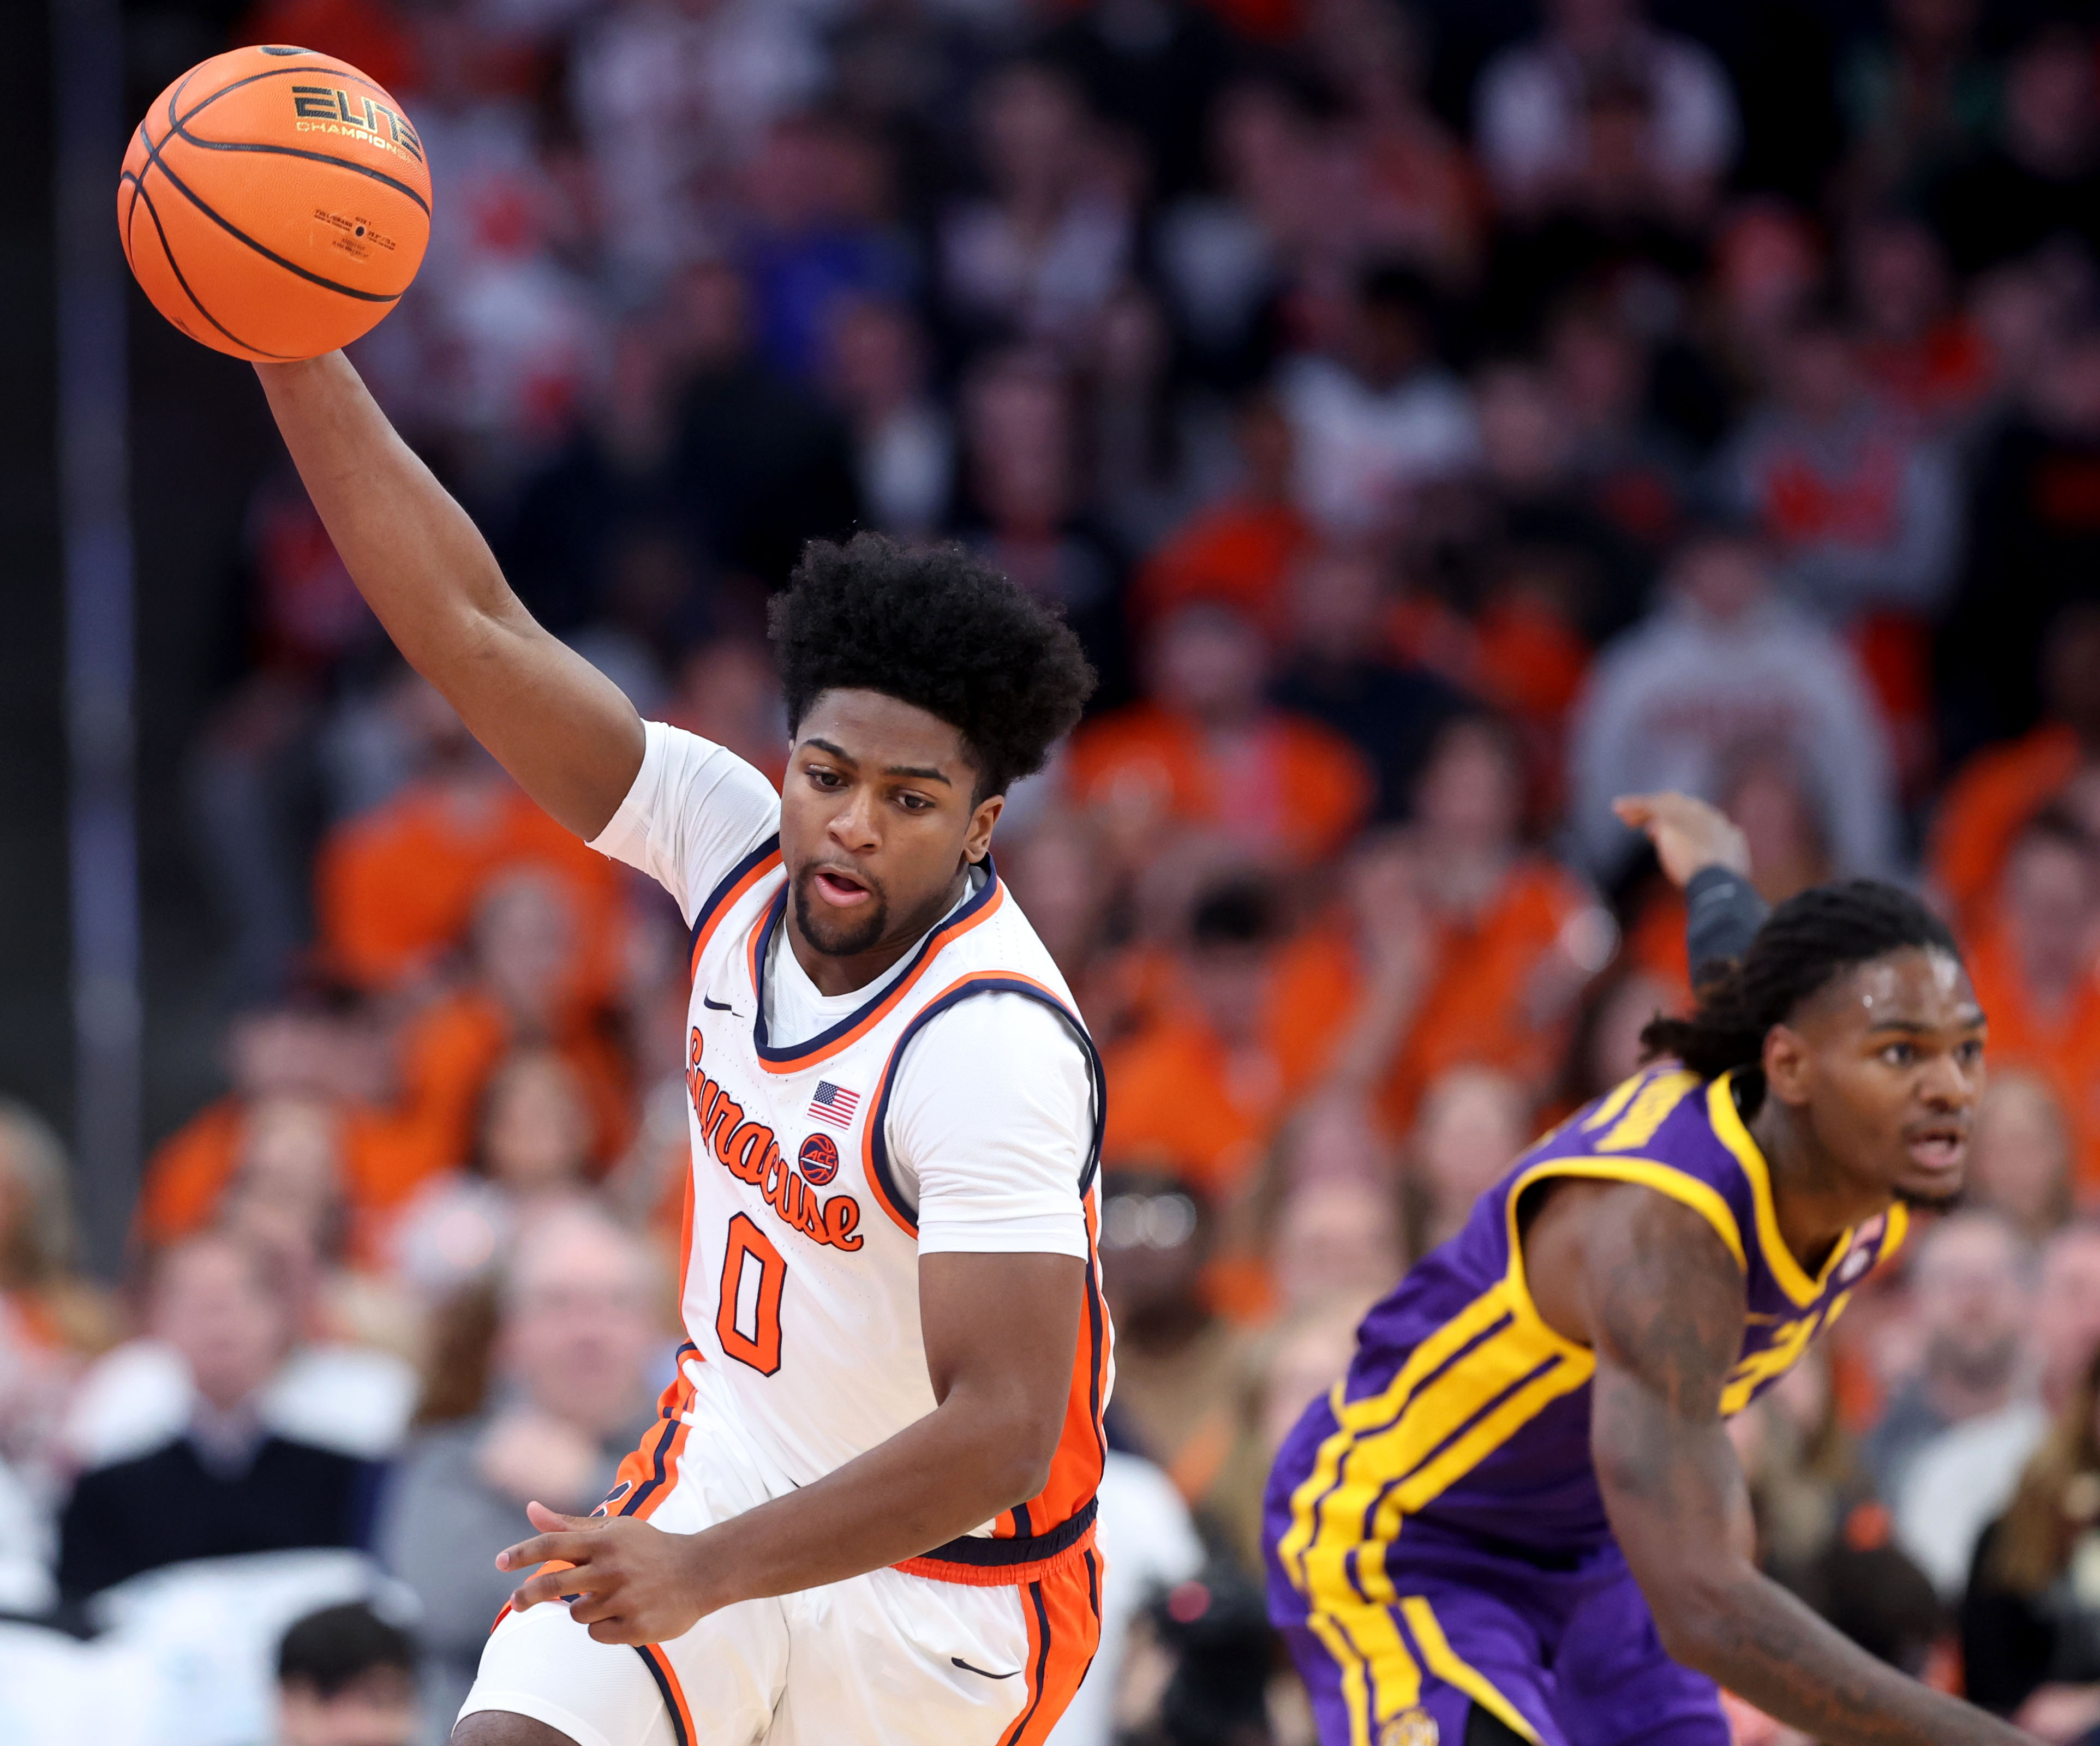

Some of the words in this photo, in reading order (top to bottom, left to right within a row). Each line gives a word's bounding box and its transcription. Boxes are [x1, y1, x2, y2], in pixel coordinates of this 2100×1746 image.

[292, 86, 423, 163] ELITE
[296, 121, 417, 166] CHAMPIONS
[686, 1025, 863, 1252] Syracuse
[804, 1150, 837, 1166] ACC
[715, 1211, 787, 1378] 0
